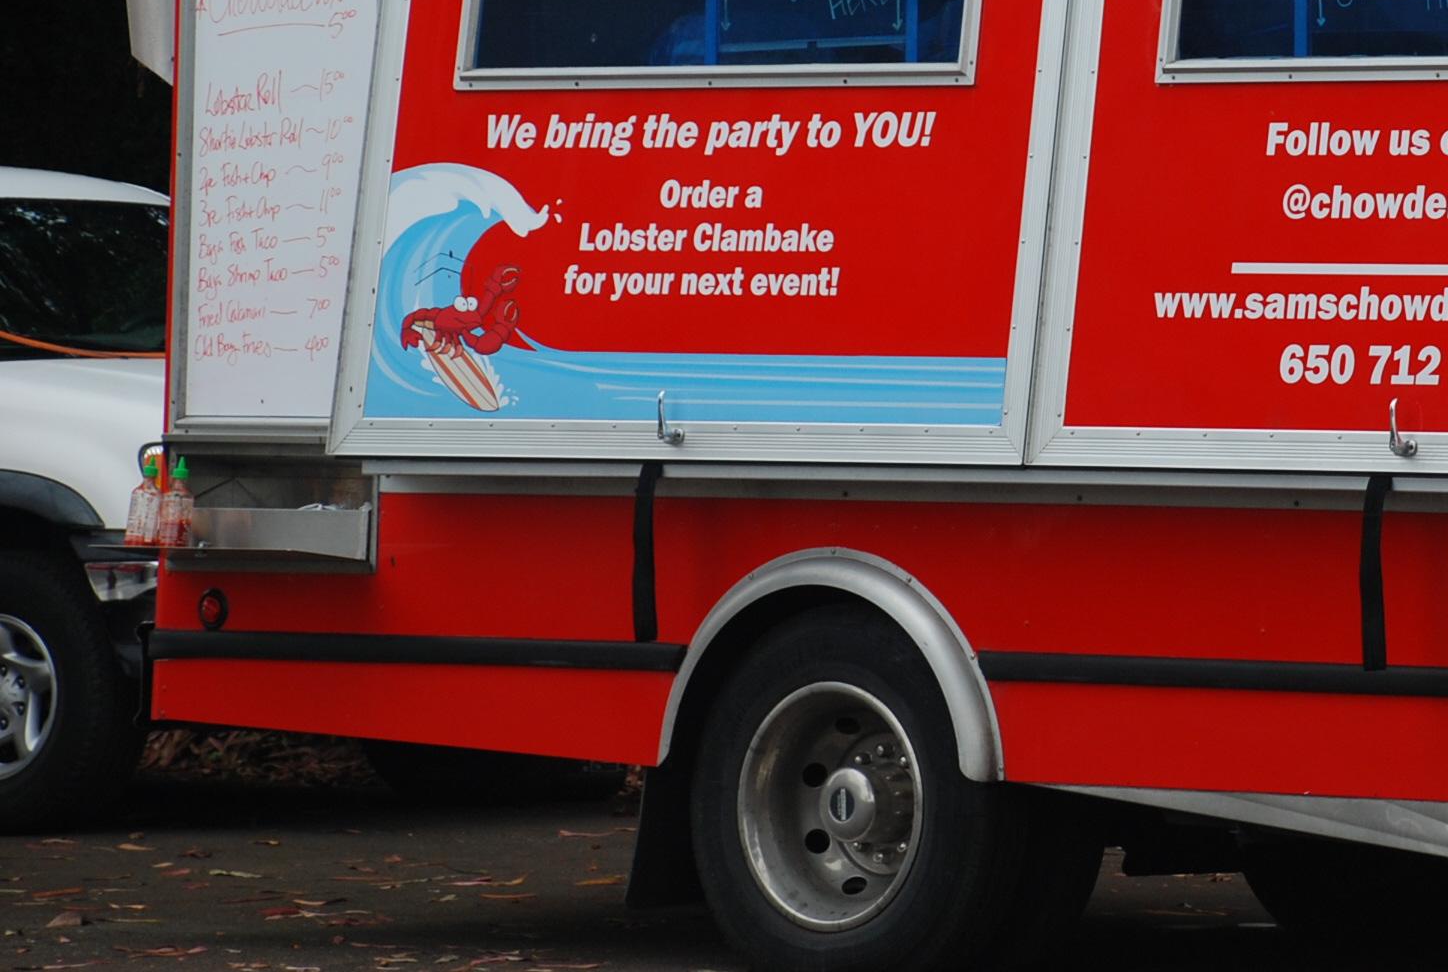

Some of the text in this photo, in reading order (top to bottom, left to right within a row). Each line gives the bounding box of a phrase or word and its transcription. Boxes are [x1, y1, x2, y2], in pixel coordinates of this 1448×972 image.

[488, 111, 937, 157] We bring the party to YOU!
[1266, 121, 1380, 156] Follow
[1389, 129, 1431, 156] us
[660, 179, 763, 209] Order a
[579, 222, 835, 253] Lobster Clambake
[564, 264, 841, 302] for your next event!
[1279, 343, 1355, 385] 650
[1368, 344, 1442, 386] 712
